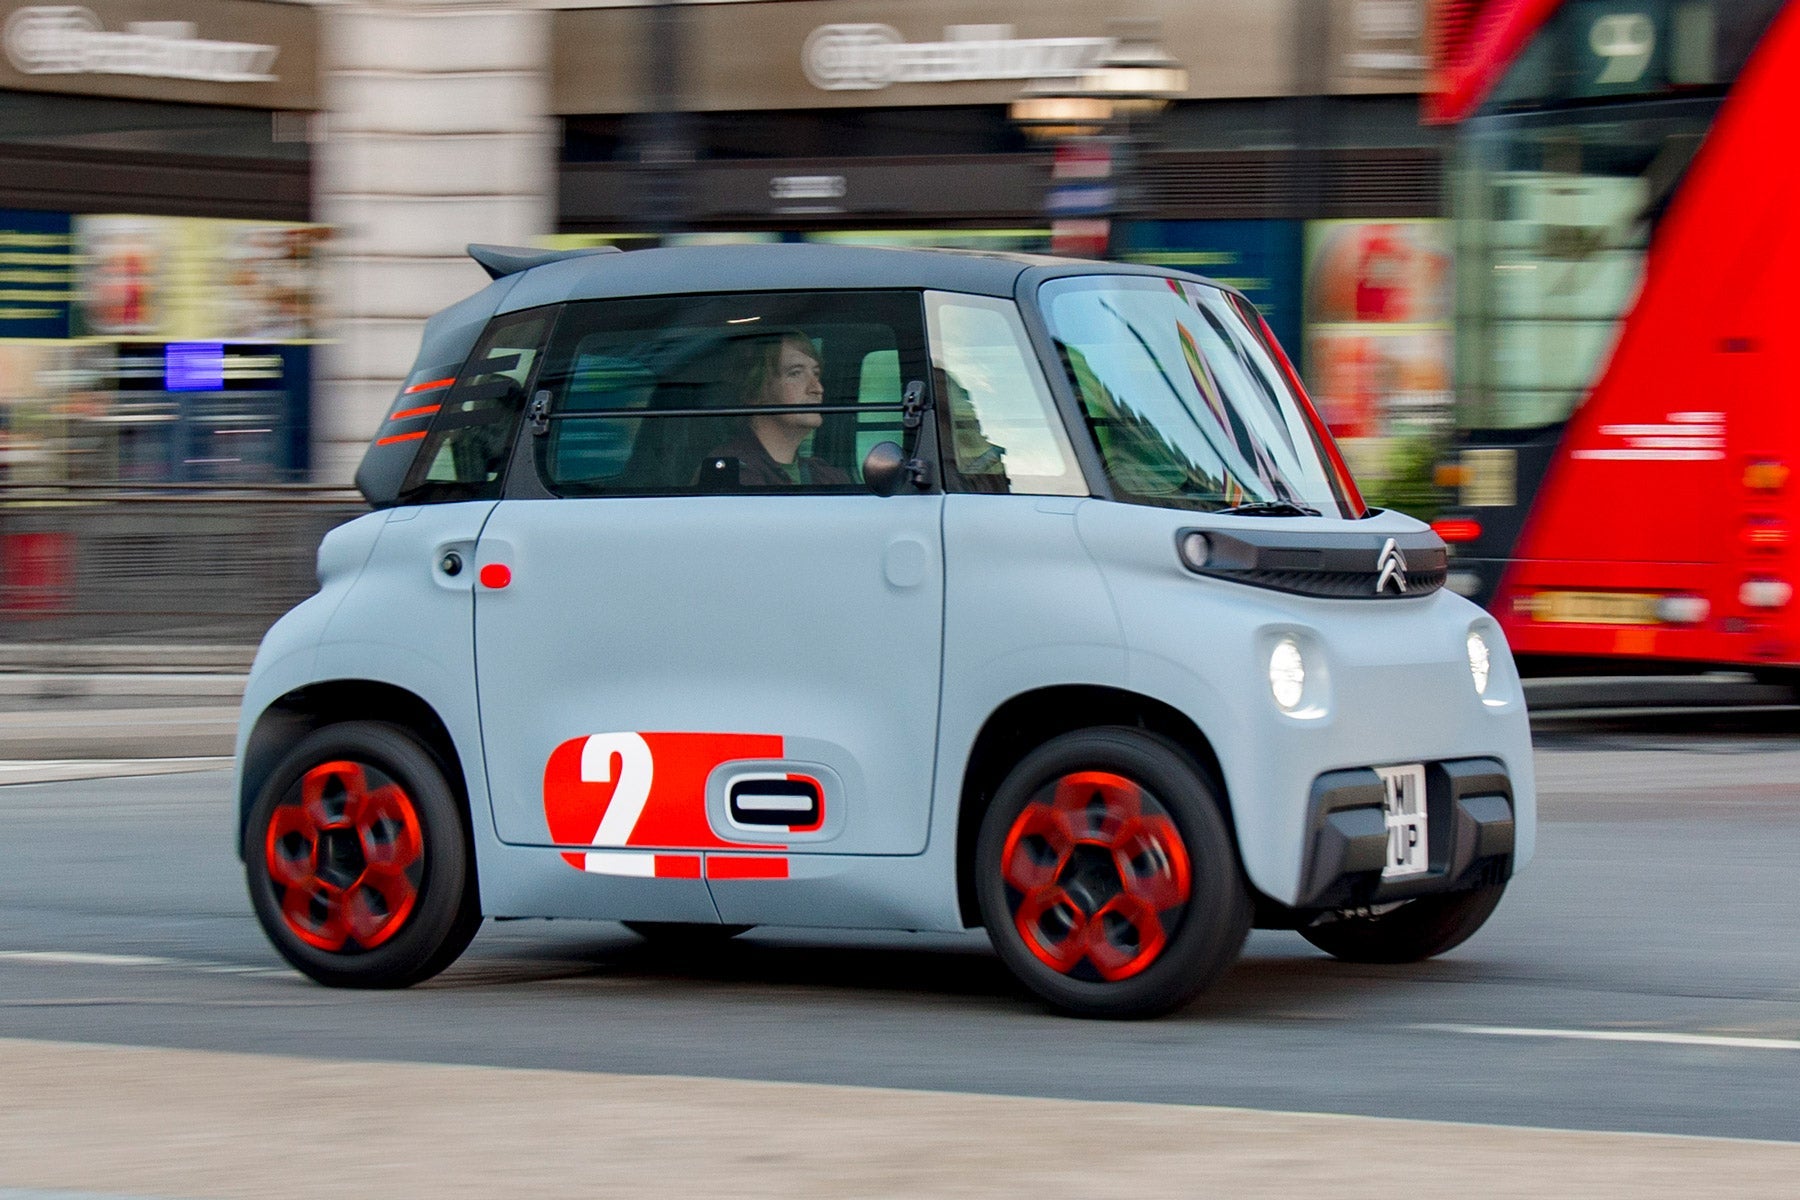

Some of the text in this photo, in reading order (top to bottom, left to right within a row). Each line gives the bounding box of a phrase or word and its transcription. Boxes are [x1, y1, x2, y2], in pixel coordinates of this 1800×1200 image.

[1588, 13, 1656, 84] 9
[581, 731, 655, 878] 2
[1387, 824, 1417, 866] UP
